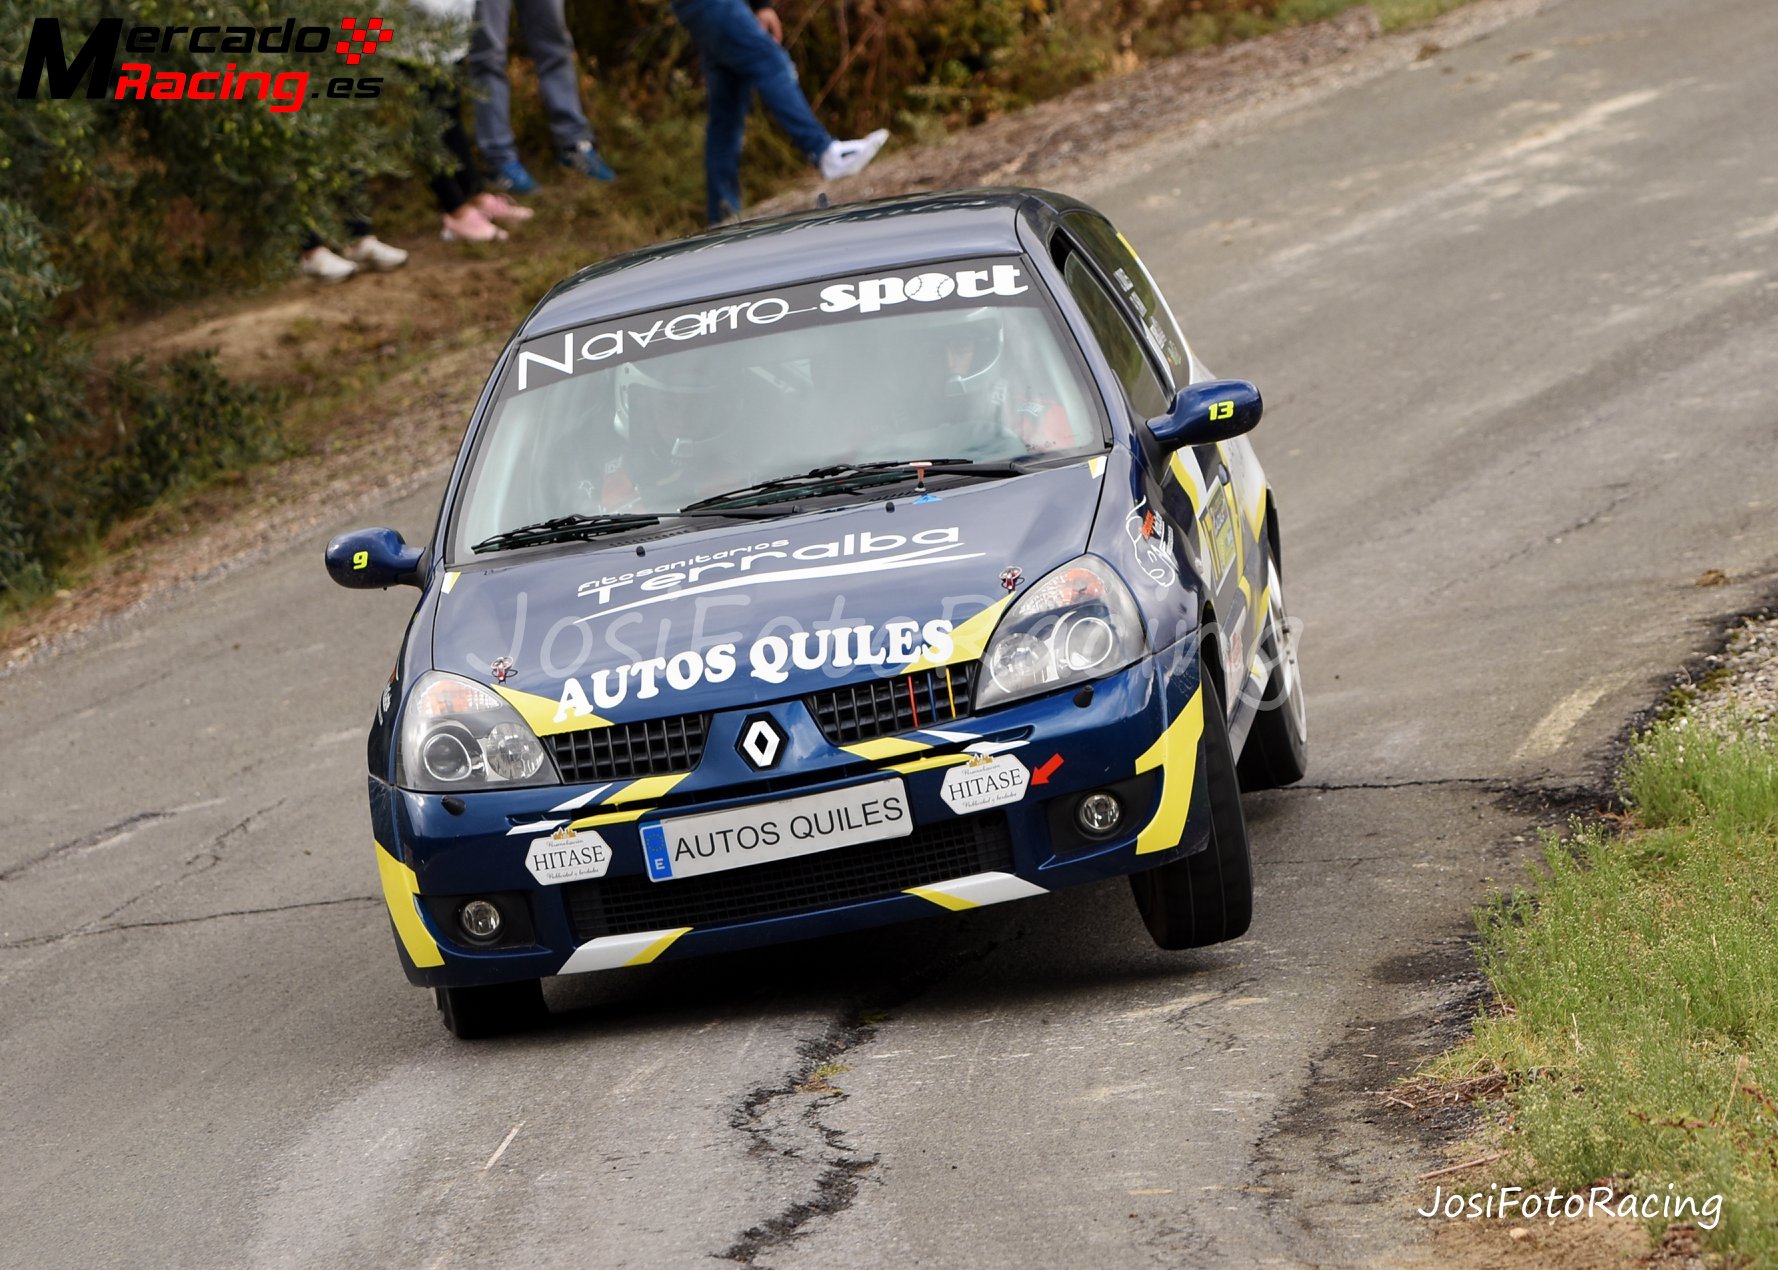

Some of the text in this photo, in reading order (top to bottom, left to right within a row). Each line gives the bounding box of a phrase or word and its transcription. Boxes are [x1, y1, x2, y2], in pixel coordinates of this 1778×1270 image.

[517, 264, 1029, 391] Navarro sport
[1208, 400, 1234, 421] 13
[352, 551, 369, 570] 9
[577, 526, 960, 605] Terralba
[552, 618, 955, 723] AUTOS QUILES
[948, 768, 1023, 801] HITASE
[674, 796, 904, 862] AUTOS QUILES
[532, 844, 606, 872] HITASE
[654, 858, 666, 870] E
